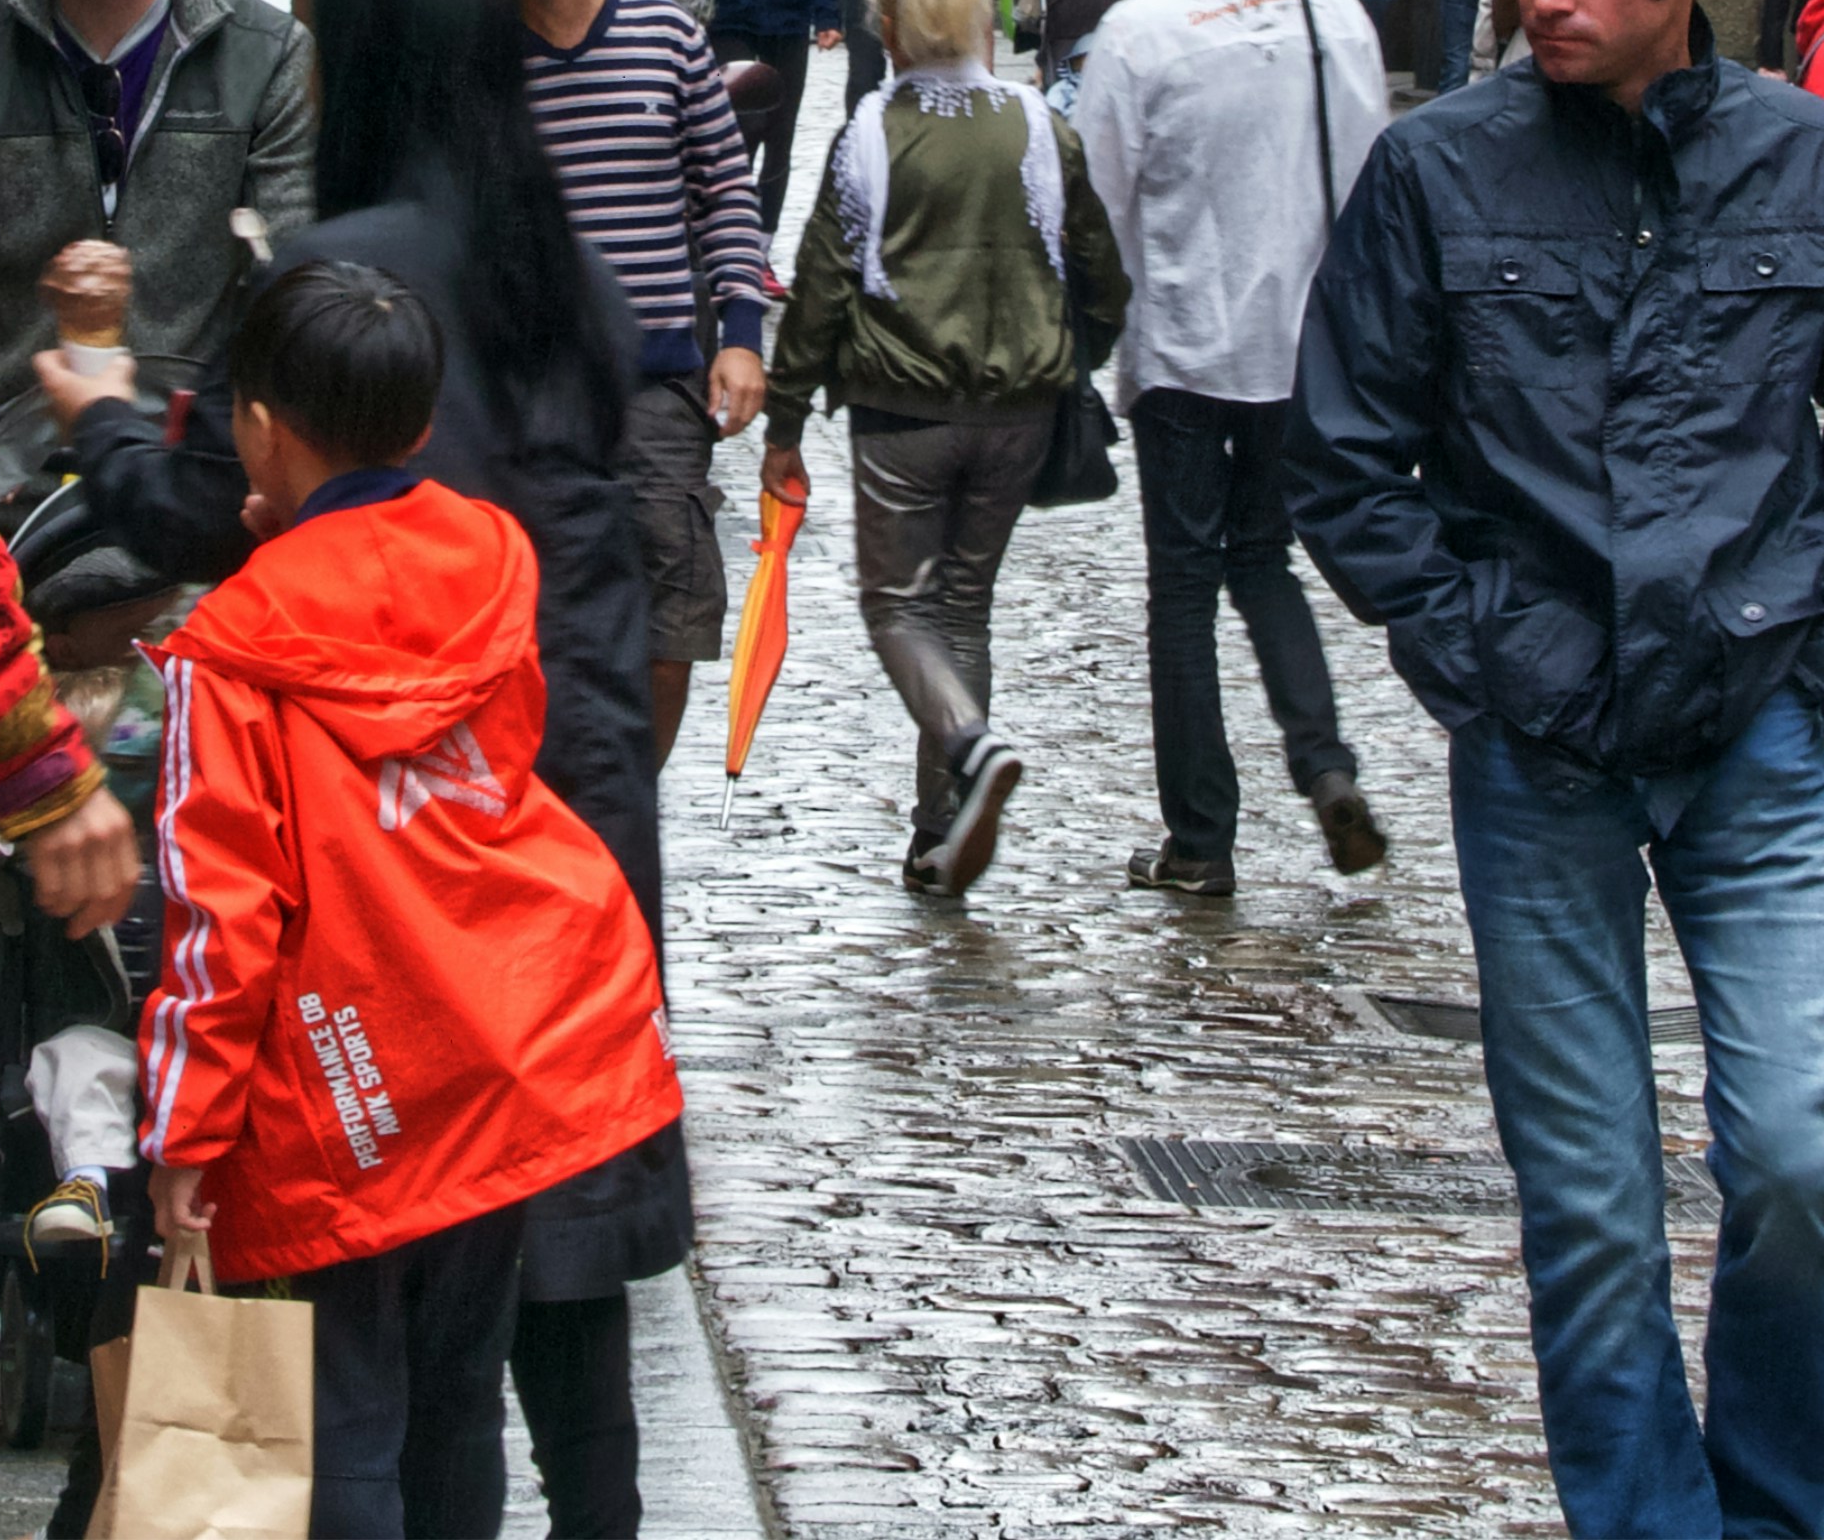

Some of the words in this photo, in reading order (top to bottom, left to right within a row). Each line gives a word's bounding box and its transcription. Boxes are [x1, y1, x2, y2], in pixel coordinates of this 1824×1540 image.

[332, 1004, 384, 1090] SPORTS
[308, 1024, 384, 1171] PERFORMANCE
[363, 1090, 402, 1137] AWK
